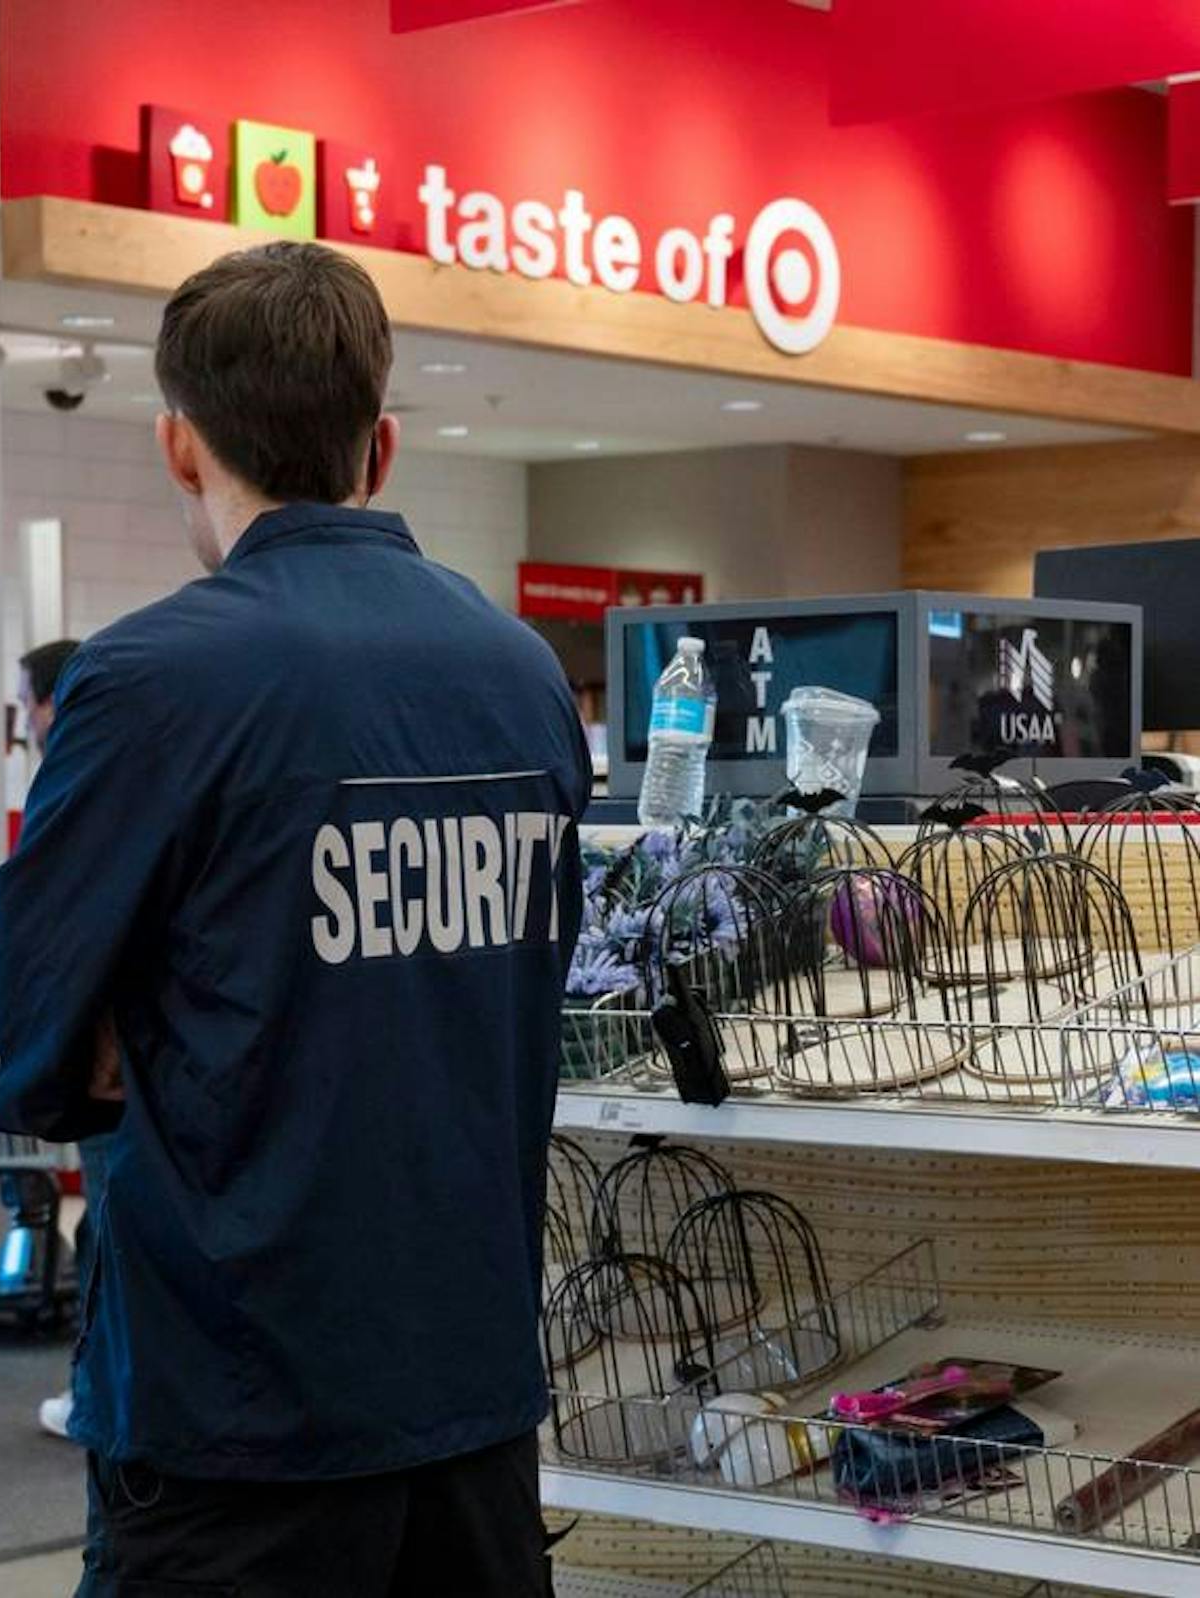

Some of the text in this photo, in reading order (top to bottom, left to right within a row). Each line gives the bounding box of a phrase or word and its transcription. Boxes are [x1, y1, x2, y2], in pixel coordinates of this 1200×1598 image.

[418, 164, 736, 307] taste of
[746, 626, 777, 753] ATM
[1000, 713, 1056, 744] USAA
[310, 811, 572, 964] SECURITY
